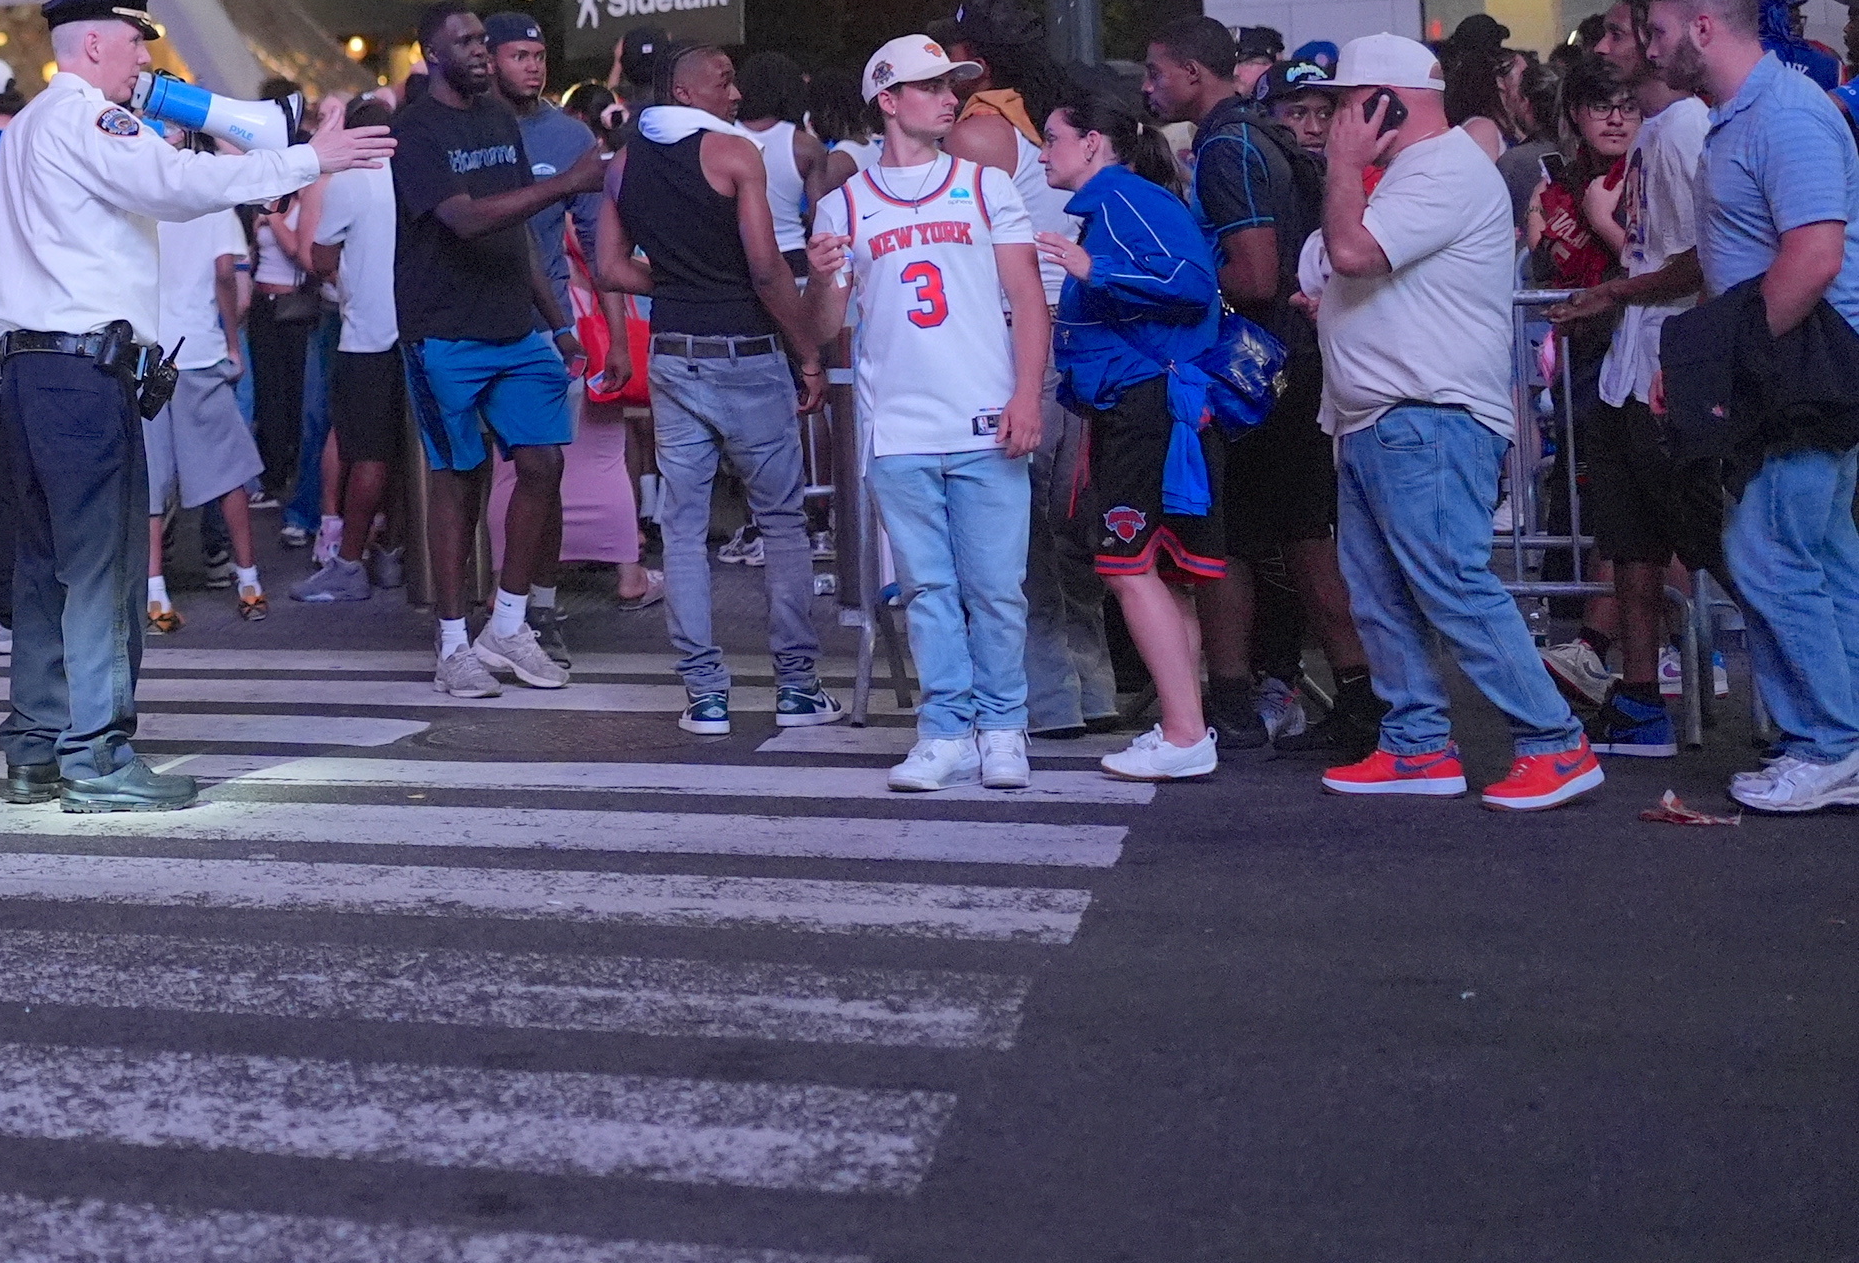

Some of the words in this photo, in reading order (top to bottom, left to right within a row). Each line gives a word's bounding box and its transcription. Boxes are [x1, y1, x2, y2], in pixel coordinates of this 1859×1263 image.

[867, 225, 914, 261] NEW
[914, 221, 973, 245] YORK
[900, 260, 949, 329] 3
